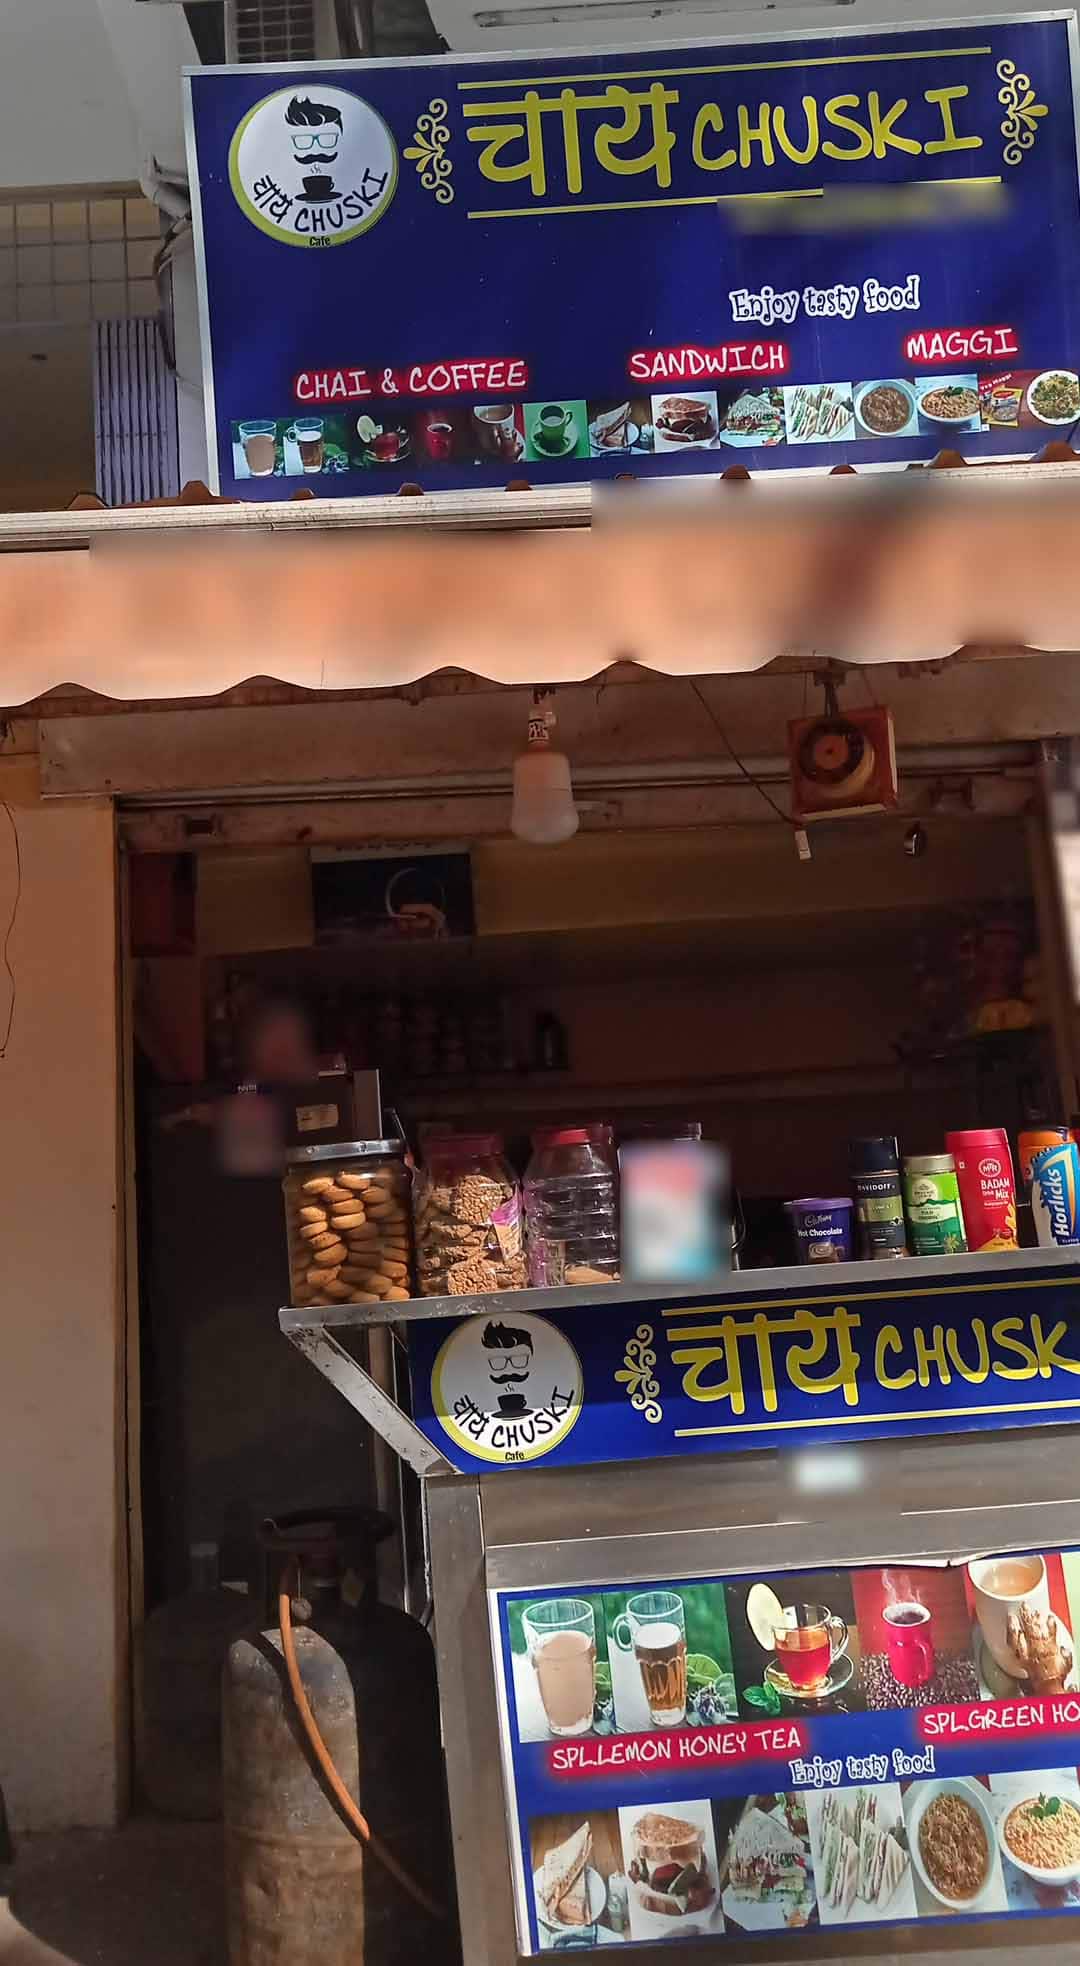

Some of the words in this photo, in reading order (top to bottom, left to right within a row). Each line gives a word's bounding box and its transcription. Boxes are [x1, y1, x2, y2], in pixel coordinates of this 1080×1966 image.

[462, 83, 680, 196] चाय
[691, 85, 983, 171] CHUSKI
[253, 175, 293, 224] चाय
[294, 168, 388, 232] CHUSKI
[309, 236, 331, 247] Cafe
[729, 286, 799, 326] Enjoy
[803, 282, 859, 319] tasty
[862, 274, 921, 312] food
[629, 344, 786, 379] SANDWICH
[906, 327, 1018, 360] MAGGI
[296, 370, 372, 400] CHAI
[380, 368, 400, 394] &
[409, 360, 527, 393] COFFEE
[980, 1178, 1010, 1190] BADAM
[995, 1189, 1009, 1200] Mix
[1046, 1168, 1070, 1238] Horlicks
[809, 1227, 843, 1237] Chocolate
[667, 1307, 861, 1415] चाय
[874, 1313, 1080, 1390] CHUSK
[453, 1395, 489, 1440] चाय
[491, 1386, 575, 1448] CHUSKI
[504, 1451, 525, 1461] Cafe
[679, 1732, 748, 1758] HONEY
[754, 1727, 801, 1751] TEA
[789, 1756, 842, 1787] Enjoy
[846, 1754, 888, 1782] tasty
[892, 1745, 935, 1776] food
